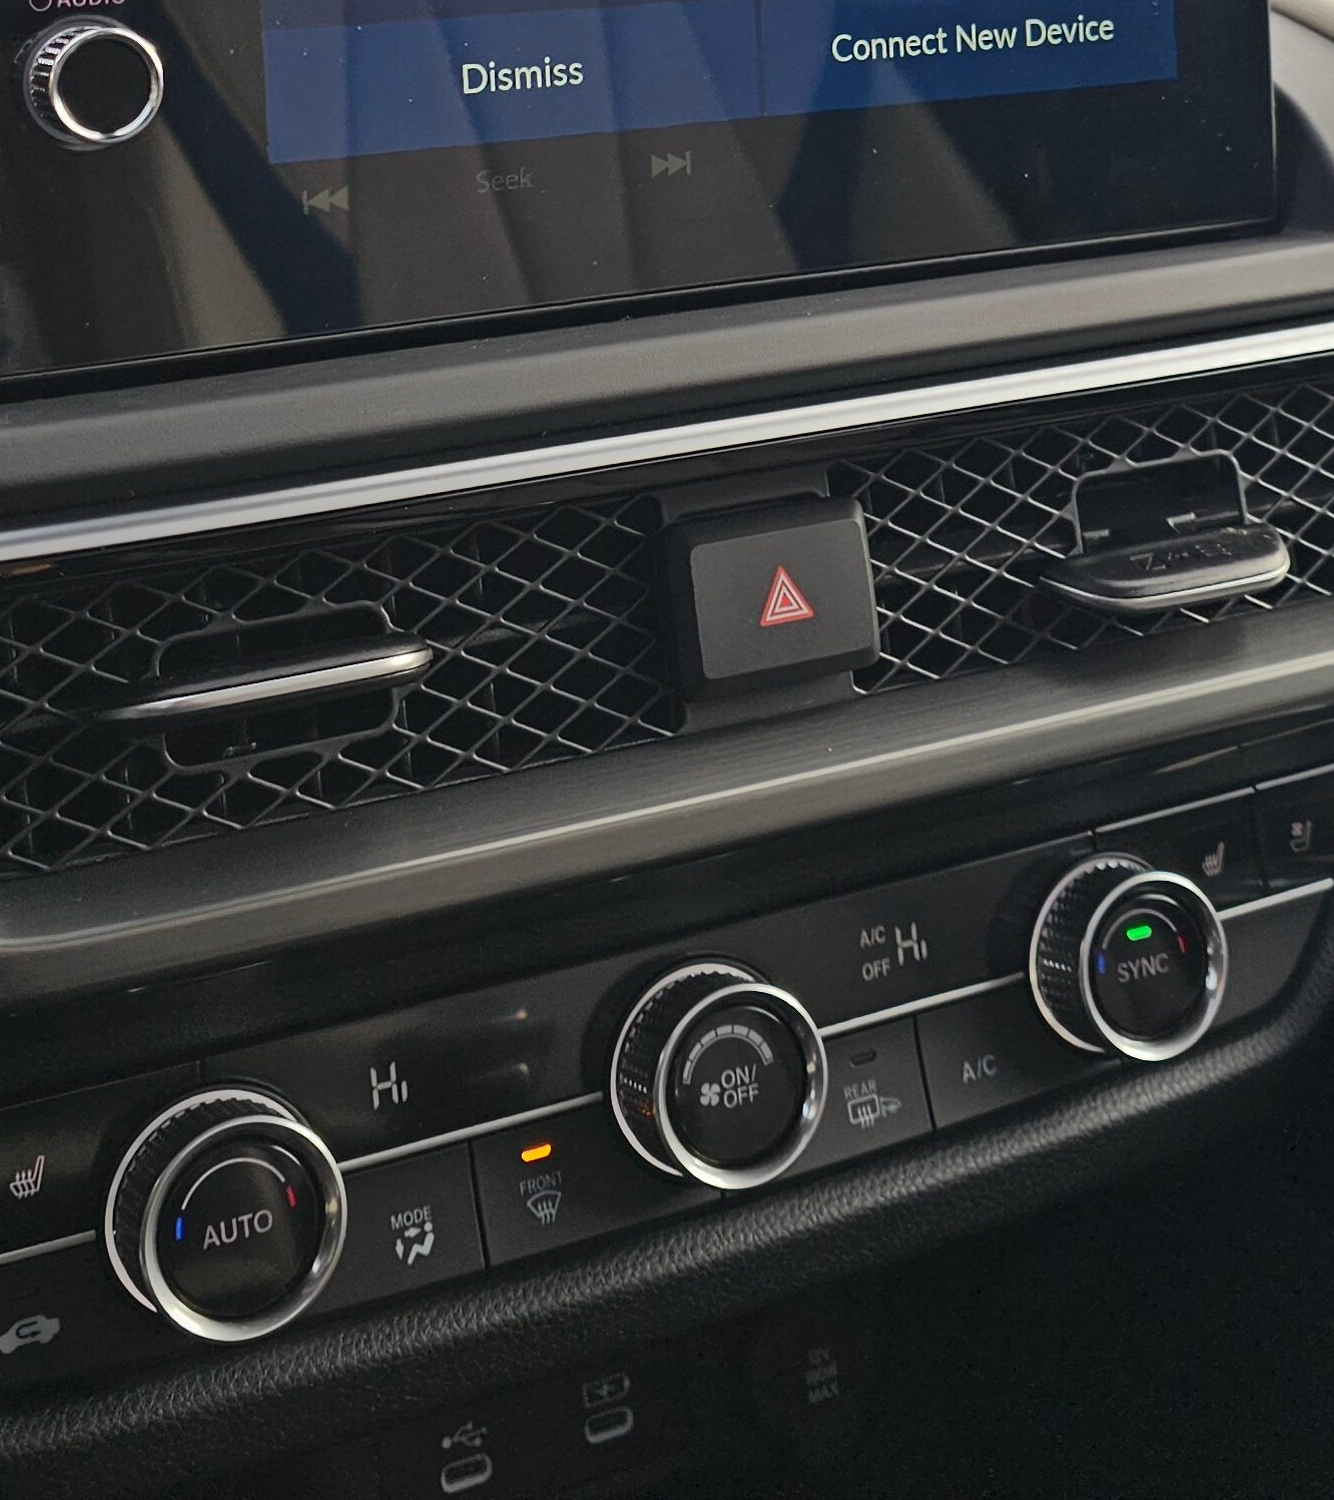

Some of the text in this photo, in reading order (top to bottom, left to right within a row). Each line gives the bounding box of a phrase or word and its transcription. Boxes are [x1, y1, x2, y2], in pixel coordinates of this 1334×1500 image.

[831, 15, 1115, 63] Connect New Device
[462, 58, 585, 95] Dismiss
[475, 168, 534, 195] Seek
[859, 924, 887, 949] A/C
[861, 958, 891, 981] OFF
[1116, 952, 1169, 982] SYNC
[720, 1063, 758, 1090] ON/
[961, 1053, 999, 1083] A/C
[722, 1082, 760, 1111] OFF
[843, 1078, 879, 1101] REAR
[518, 1169, 563, 1197] FRONT
[201, 1209, 274, 1251] AUTO
[389, 1205, 433, 1231] MODE
